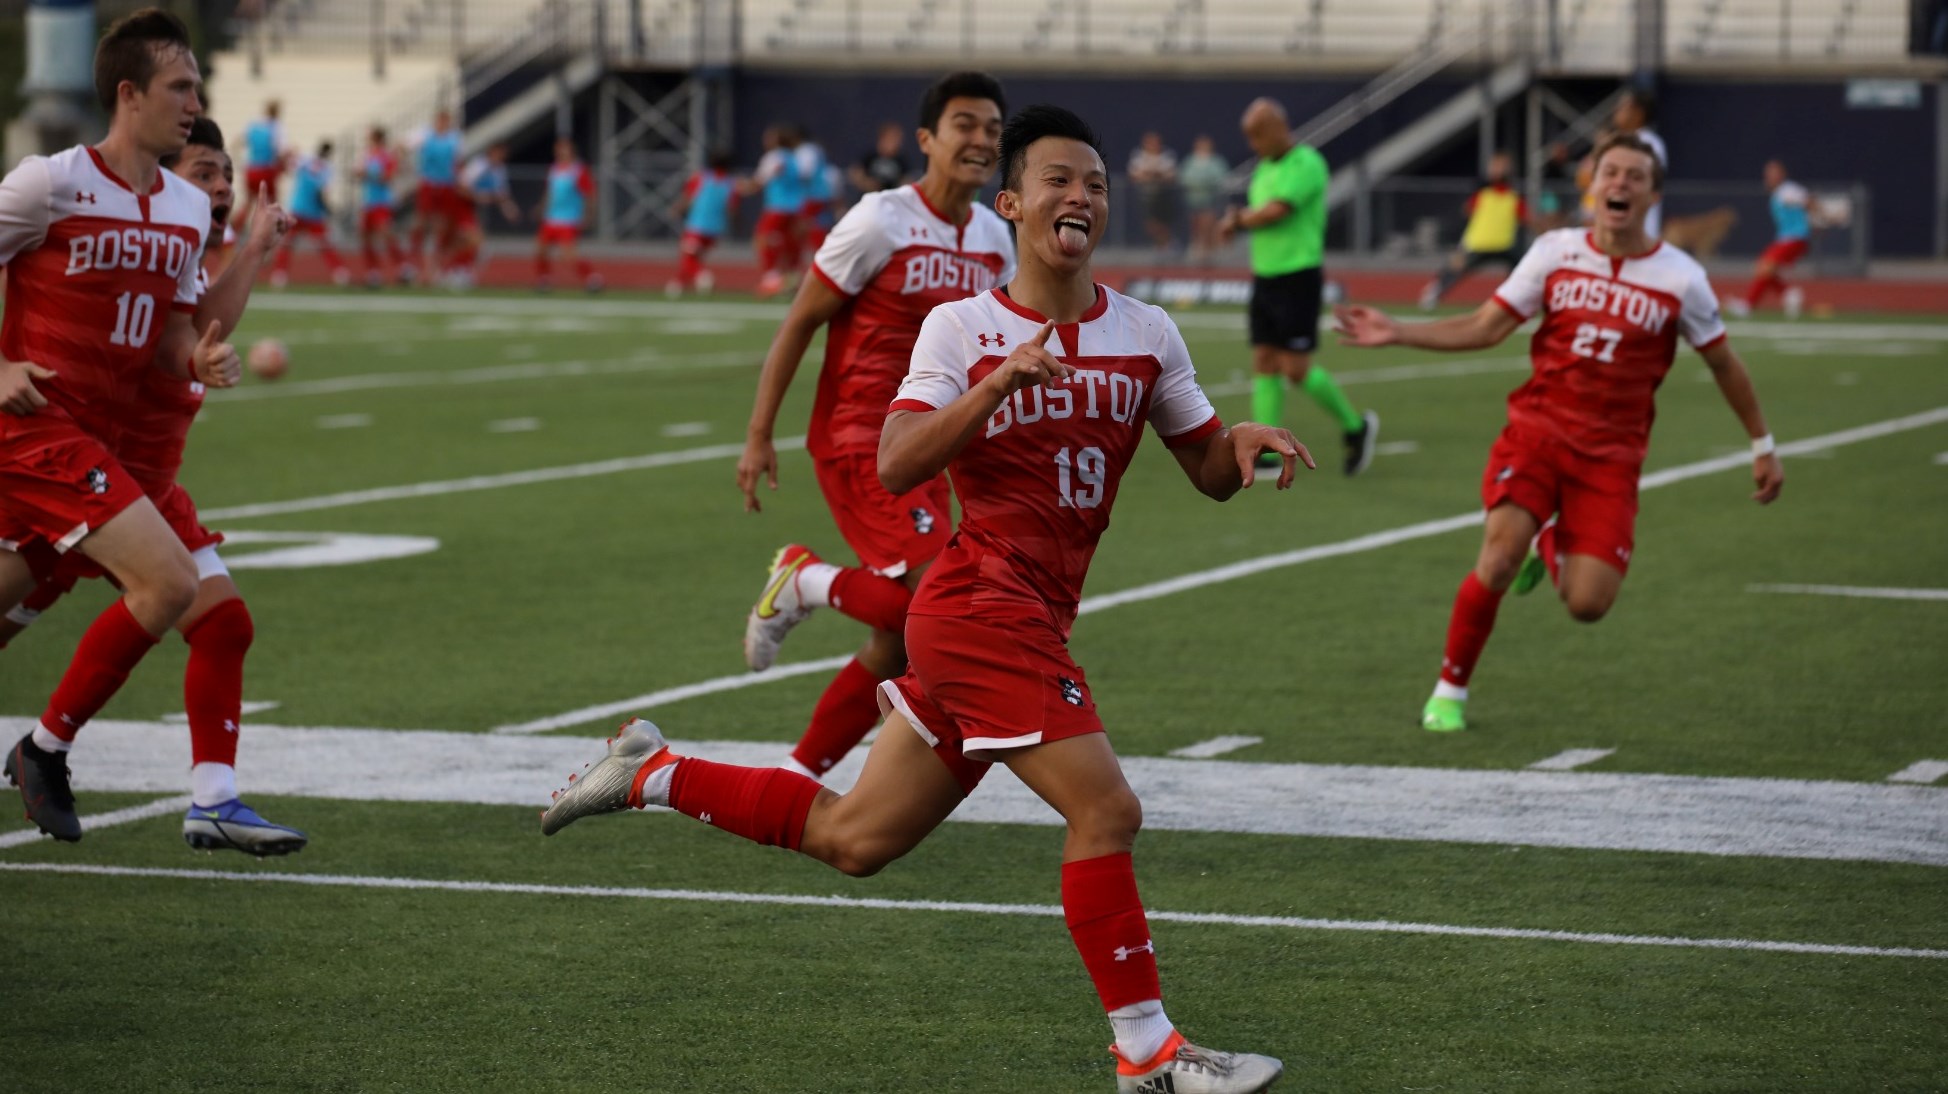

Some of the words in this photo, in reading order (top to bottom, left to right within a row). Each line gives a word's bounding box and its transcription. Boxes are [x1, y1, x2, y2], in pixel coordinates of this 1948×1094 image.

[901, 251, 995, 296] BOSTO
[109, 291, 155, 348] 10
[1550, 276, 1670, 336] BOSTON
[1570, 322, 1623, 363] 27
[1054, 446, 1106, 509] 19
